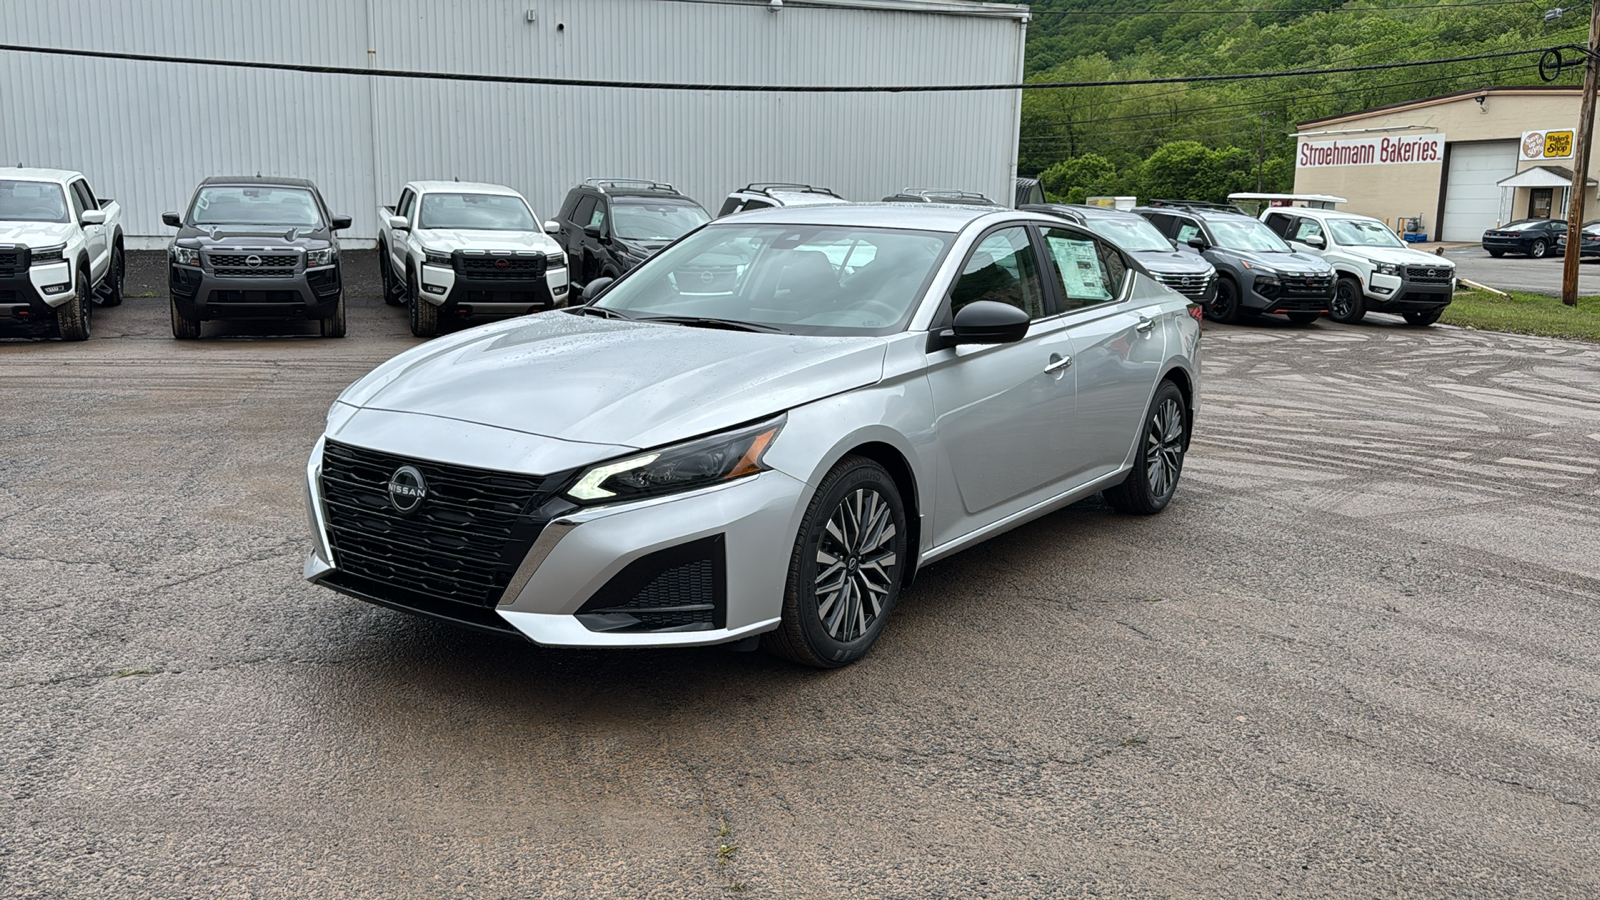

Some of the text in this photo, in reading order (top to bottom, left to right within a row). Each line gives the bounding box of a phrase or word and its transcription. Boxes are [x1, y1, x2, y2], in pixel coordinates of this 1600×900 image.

[1525, 134, 1539, 145] Save
[1300, 136, 1438, 167] Stroehmann Bakeries
[1547, 143, 1567, 153] Shop
[388, 482, 426, 498] NISSAN
